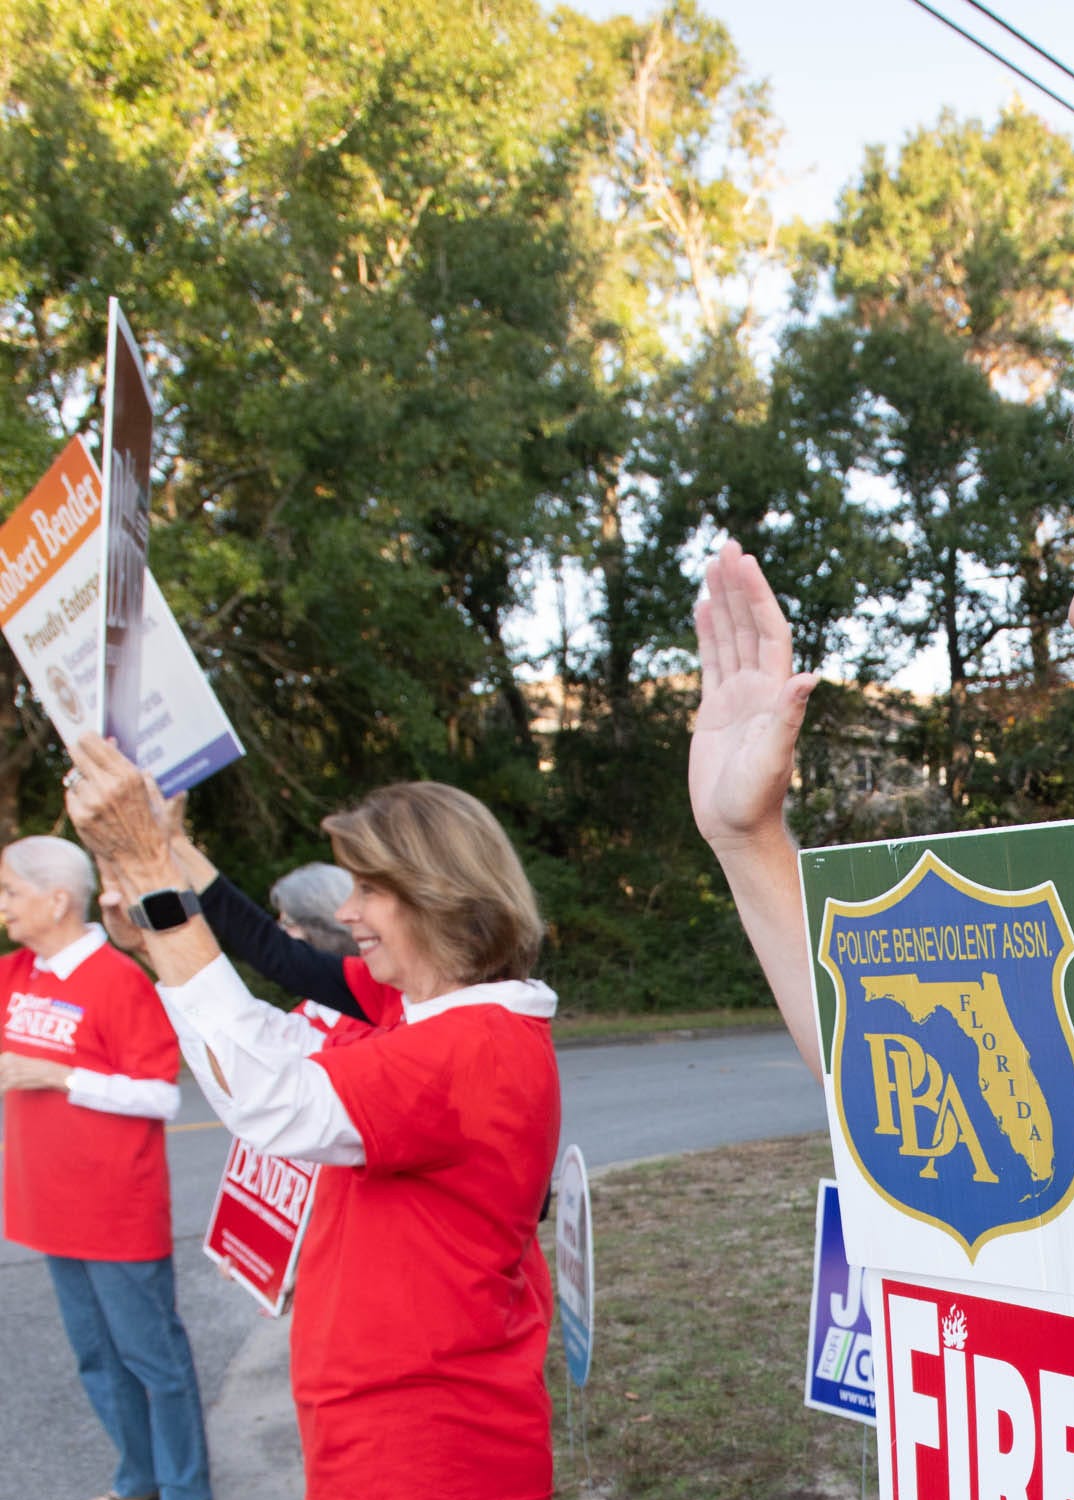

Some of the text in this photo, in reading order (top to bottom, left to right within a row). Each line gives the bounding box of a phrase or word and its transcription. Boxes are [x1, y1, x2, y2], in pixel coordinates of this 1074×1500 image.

[0, 534, 49, 612] obert
[30, 472, 100, 560] Bender
[836, 920, 1053, 965] POLICE BENEVOLENT ASSN.
[863, 1032, 999, 1184] PBA
[959, 993, 1042, 1143] FLORIDA
